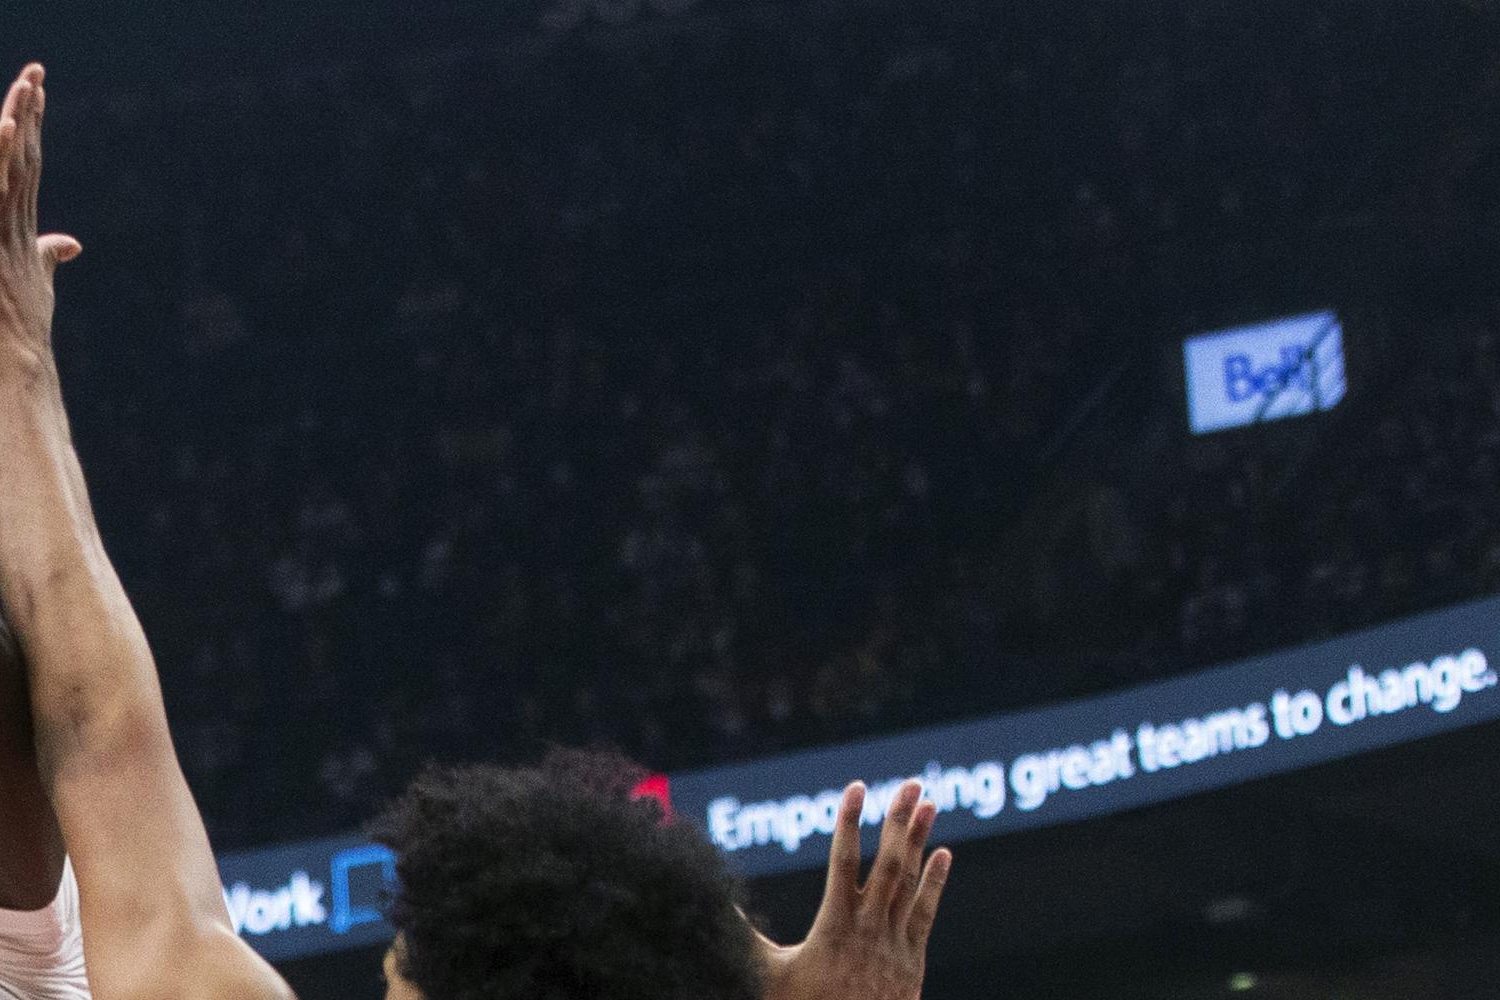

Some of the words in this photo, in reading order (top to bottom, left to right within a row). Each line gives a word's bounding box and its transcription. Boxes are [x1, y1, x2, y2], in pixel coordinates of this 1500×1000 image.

[1009, 726, 1135, 811] great
[1136, 702, 1270, 772] teams
[1271, 688, 1324, 740] to
[1325, 648, 1499, 713] change.
